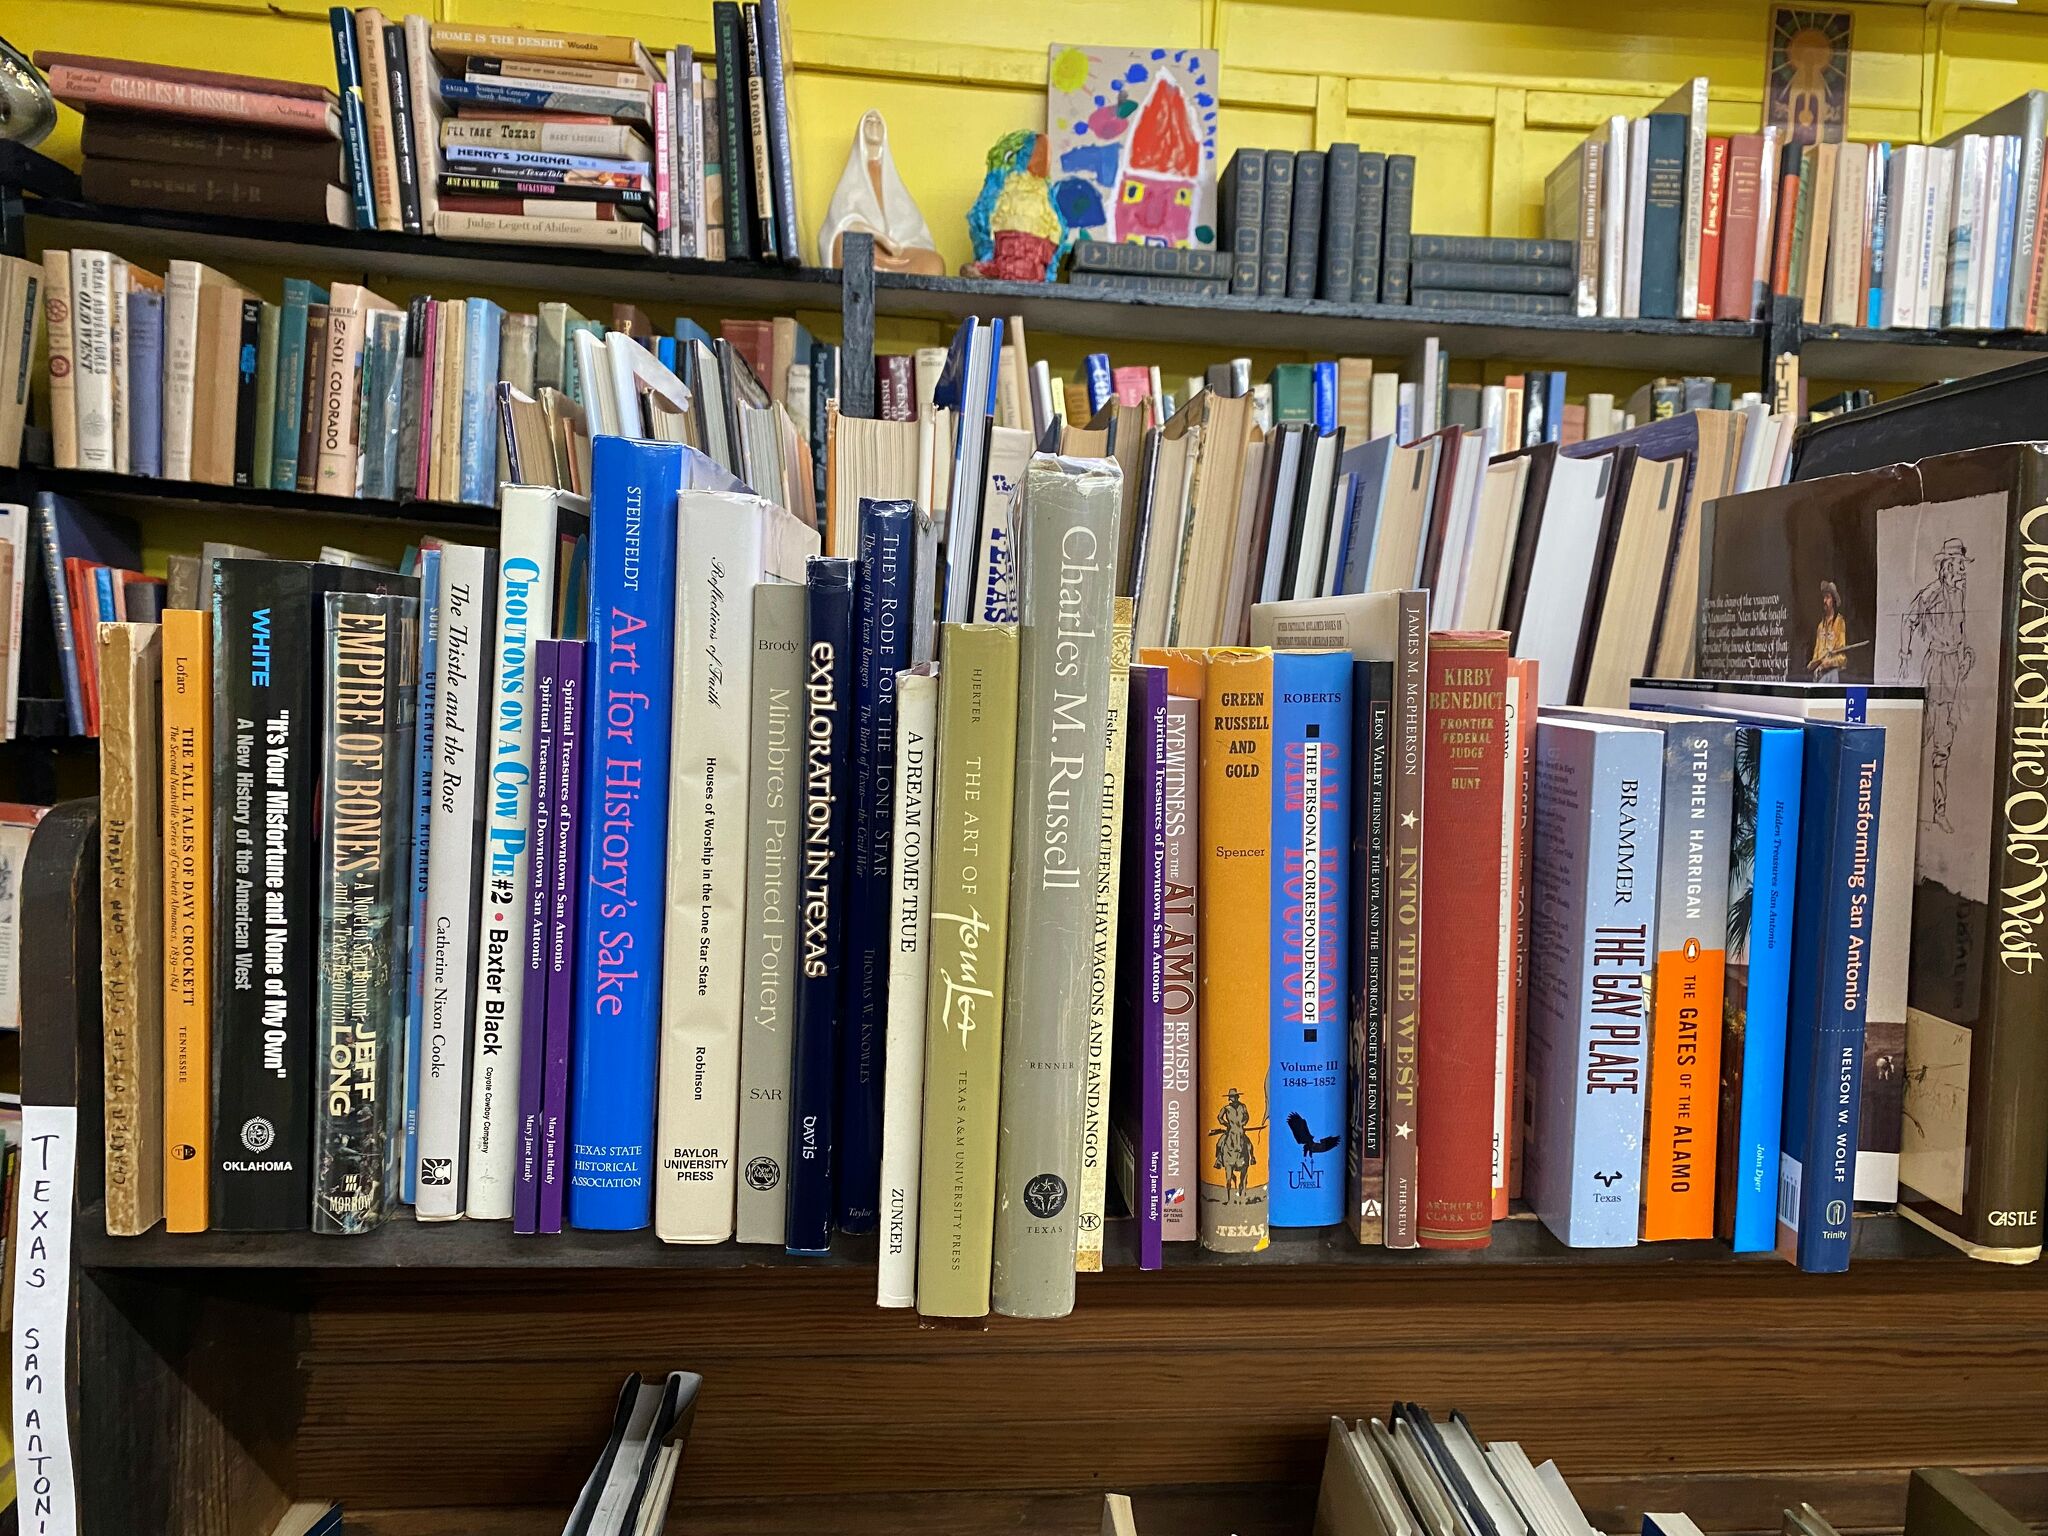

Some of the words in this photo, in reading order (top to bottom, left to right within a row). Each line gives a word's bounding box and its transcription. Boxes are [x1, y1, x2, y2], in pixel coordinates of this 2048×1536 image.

[436, 31, 471, 41] HOME
[476, 32, 485, 42] IS
[490, 33, 514, 45] THE
[518, 35, 565, 48] DESERT
[567, 41, 598, 50] Woodin
[110, 77, 172, 103] CHARLES
[190, 88, 249, 112] RUSSELL
[470, 127, 492, 137] TAKE
[500, 125, 536, 139] Texas
[722, 24, 734, 101] BEFORE
[731, 190, 740, 242] WIRE
[458, 148, 510, 159] HENRY'S
[516, 153, 572, 165] JOURNAL
[2029, 138, 2043, 174] GONE
[623, 191, 641, 200] TEXAS
[2026, 177, 2039, 213] FROM
[467, 217, 496, 229] Judge
[499, 219, 529, 230] Legett
[532, 221, 542, 231] of
[545, 222, 582, 233] Abilene
[2022, 218, 2036, 256] TEXAS
[79, 291, 91, 325] OLD
[80, 328, 94, 374] WEST
[331, 338, 345, 368] SOL
[326, 372, 342, 449] COLORADO
[624, 486, 642, 591] STEINFELDT
[882, 534, 899, 592] THEY
[449, 583, 470, 617] The
[1055, 525, 1098, 677] Charles
[252, 608, 271, 687] WHITE
[502, 557, 540, 694] CROUTONS
[609, 607, 648, 675] Art
[758, 640, 799, 653] Brody
[879, 599, 898, 655] RODE
[1406, 608, 1420, 655] JAMES
[176, 656, 189, 694] Lofaro
[337, 611, 386, 726] EMPIRE
[446, 624, 469, 687] Thistle
[1408, 661, 1418, 678] M.
[1443, 668, 1494, 686] KIRBY
[878, 667, 893, 704] FOR
[1222, 692, 1264, 707] GREEN
[1282, 693, 1342, 703] ROBERTS
[1429, 692, 1503, 710] BENEDICT
[236, 718, 253, 730] A
[445, 691, 463, 730] and
[500, 700, 523, 734] ON
[607, 689, 649, 744] for
[1051, 689, 1088, 743] M.
[1215, 717, 1270, 730] RUSSELL
[1405, 683, 1418, 776] McPHERSON
[182, 728, 194, 758] THE
[236, 735, 253, 767] New
[334, 733, 384, 770] OF
[443, 736, 462, 766] the
[500, 738, 521, 757] A
[766, 688, 790, 808] Mimbres
[877, 715, 891, 752] THE
[908, 731, 923, 746] A
[1229, 741, 1256, 754] AND
[182, 762, 194, 800] TALL
[265, 749, 288, 787] Your
[492, 760, 530, 820] COW
[905, 749, 924, 828] DREAM
[1226, 764, 1260, 778] GOLD
[1451, 778, 1481, 790] HUNT
[1690, 739, 1708, 819] STEPHEN
[233, 773, 253, 824] History
[441, 770, 462, 814] Rose
[874, 764, 892, 827] LONE
[182, 806, 194, 852] TALES
[235, 829, 252, 844] of
[265, 791, 288, 888] Misfortune
[589, 758, 643, 919] History's
[1041, 750, 1085, 891] Russell
[1848, 760, 1877, 888] Transforming
[235, 850, 253, 874] the
[490, 825, 527, 877] PIE
[873, 830, 890, 877] STAR
[903, 831, 922, 890] COME
[1216, 846, 1266, 858] Spencer
[1614, 779, 1638, 907] BRAMMER
[182, 857, 194, 877] OF
[763, 817, 787, 925] Painted
[1398, 845, 1418, 926] INTO
[1686, 829, 1704, 919] HARRIGAN
[183, 881, 195, 920] DAVY
[235, 879, 252, 949] American
[265, 892, 284, 924] and
[491, 879, 513, 905] #2
[1850, 894, 1867, 929] San
[900, 896, 918, 953] TRUE
[1594, 924, 1647, 966] THE
[182, 925, 195, 1007] CROCKETT
[234, 953, 252, 990] West
[264, 928, 287, 974] None
[434, 916, 450, 984] Catherine
[485, 928, 508, 994] Baxter
[1398, 933, 1416, 1001] THE
[264, 979, 287, 996] of
[595, 930, 638, 1016] Sake
[754, 933, 783, 1032] Pottery
[1590, 973, 1642, 1017] GAY
[1684, 976, 1696, 999] THE
[1844, 935, 1864, 1011] Antonio
[261, 1000, 286, 1026] My
[432, 987, 448, 1030] Nixon
[482, 1000, 504, 1056] Black
[430, 1034, 445, 1079] Cooke
[1396, 1011, 1414, 1106] WEST
[1677, 1007, 1698, 1066] GATES
[329, 1025, 350, 1117] LONG
[353, 1023, 376, 1102] JEFF
[1586, 1024, 1640, 1094] PLACE
[1838, 1047, 1853, 1104] NELSON
[1679, 1074, 1692, 1089] OF
[1678, 1096, 1691, 1119] THE
[1836, 1110, 1849, 1127] W.
[1168, 1101, 1180, 1176] GRONEMAN
[1671, 1126, 1692, 1193] ALAMO
[1755, 1144, 1765, 1167] John
[1834, 1133, 1846, 1182] WOLFF
[223, 1161, 293, 1172] OKLAHOMA
[1753, 1169, 1764, 1192] Dyer
[26, 1134, 60, 1288] TEXAS
[889, 1188, 904, 1255] ZUNKER
[1398, 1178, 1407, 1236] ATHENEUM
[1987, 1210, 2038, 1226] CASTLE
[1822, 1231, 1847, 1241] Trinity
[24, 1328, 43, 1394] SAN
